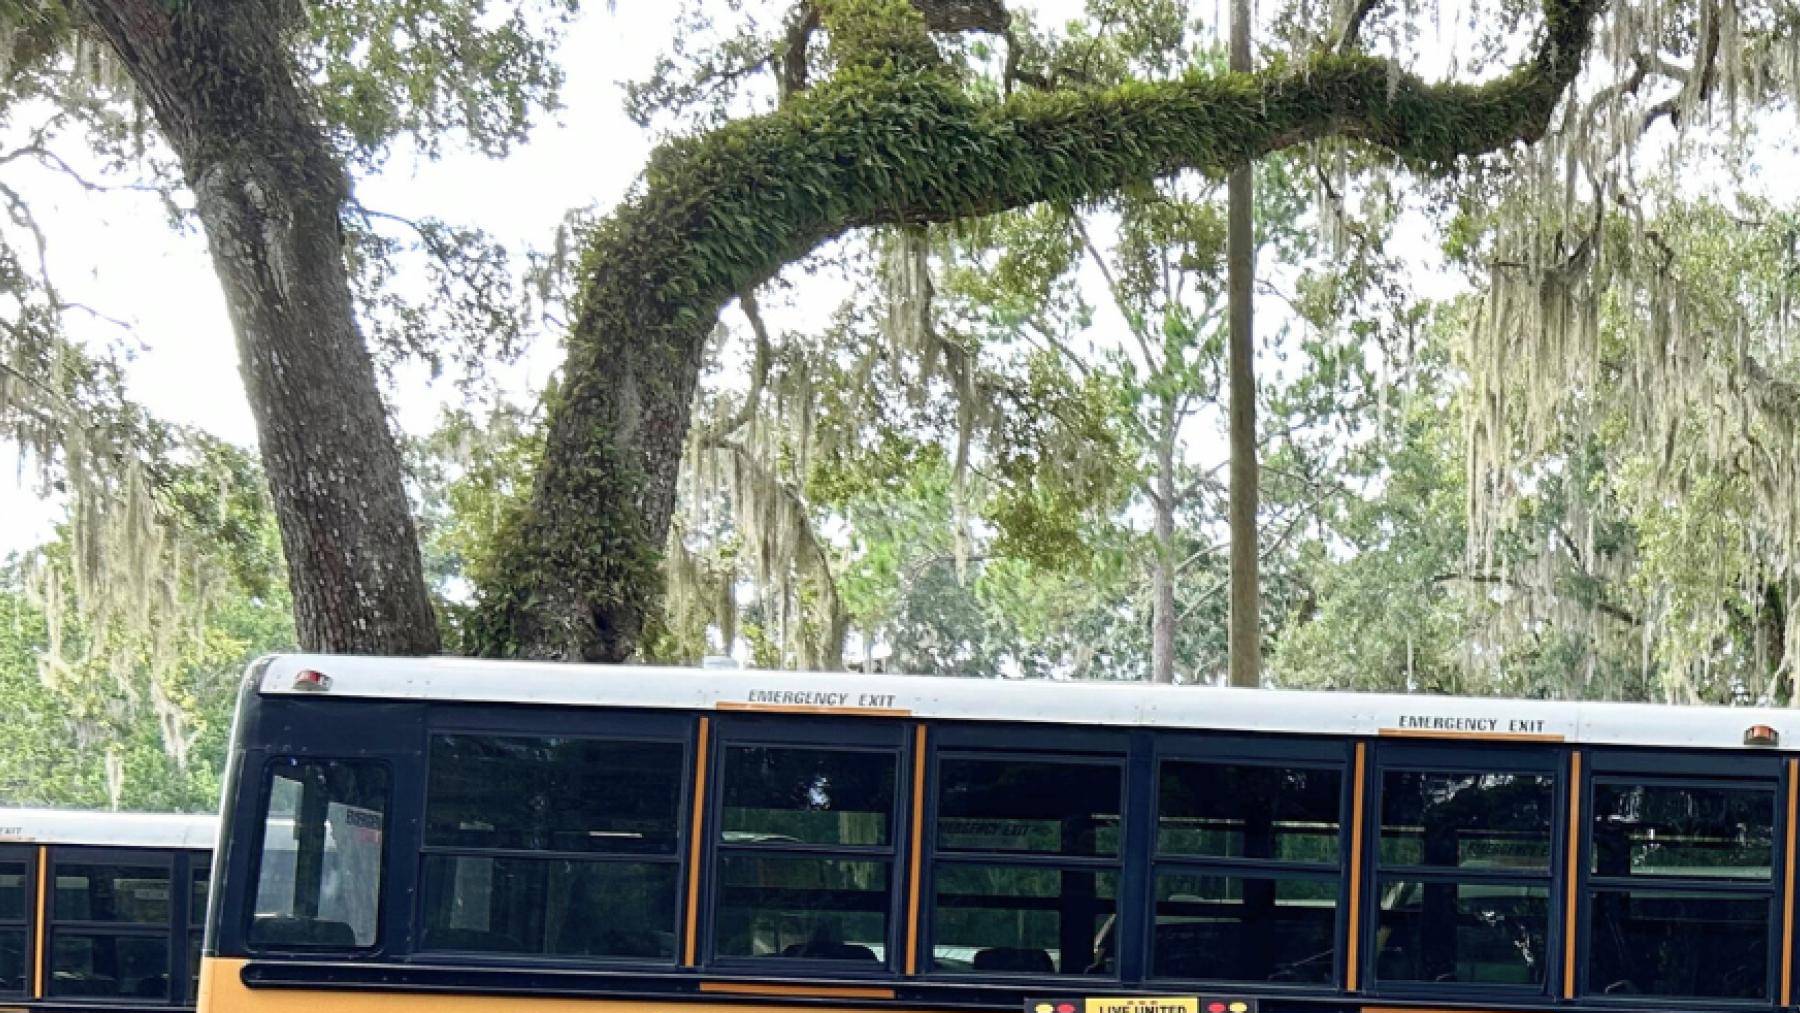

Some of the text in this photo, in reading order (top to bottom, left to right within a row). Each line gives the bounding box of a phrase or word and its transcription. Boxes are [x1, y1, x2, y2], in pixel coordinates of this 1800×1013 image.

[748, 689, 896, 707] EMERGENCY EXIT
[1399, 715, 1545, 733] EMERGENCY EXIT
